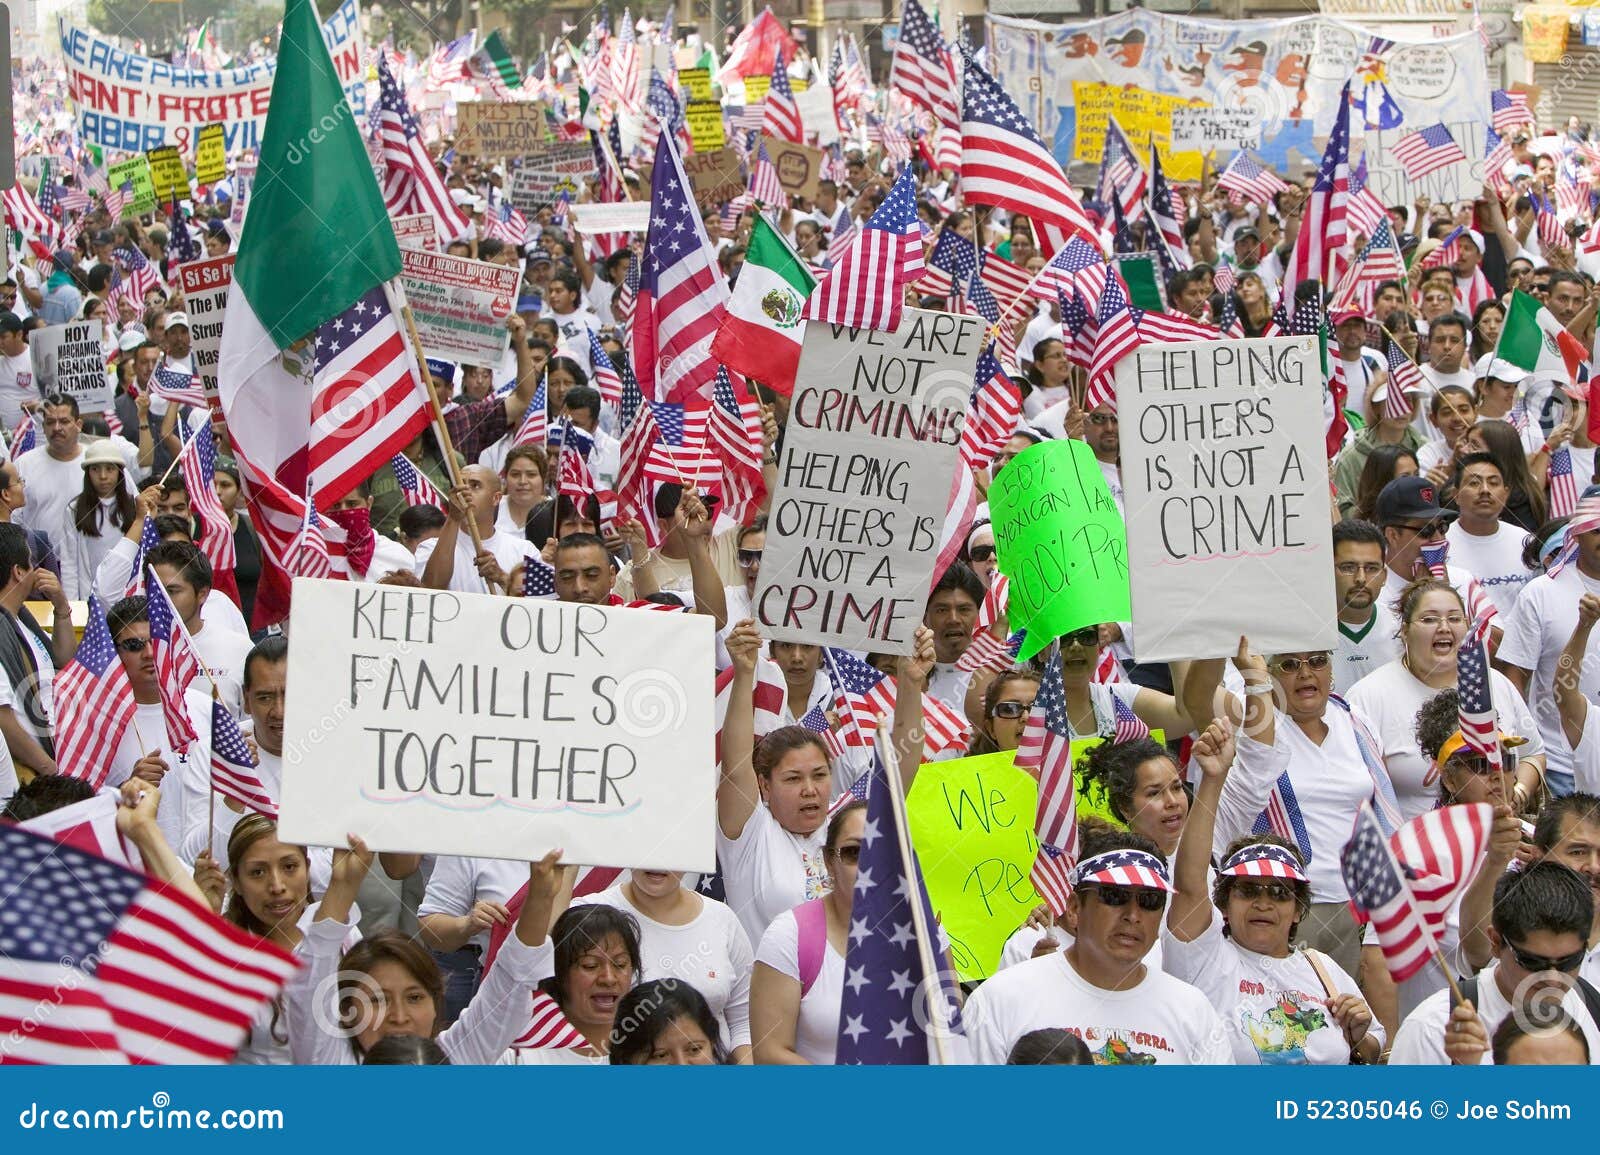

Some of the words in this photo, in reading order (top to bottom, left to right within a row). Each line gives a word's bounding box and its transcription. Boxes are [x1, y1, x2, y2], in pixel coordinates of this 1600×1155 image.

[61, 17, 89, 65] WE
[90, 39, 149, 82] ARE
[150, 62, 222, 88] PART
[158, 88, 271, 122] PROTE
[460, 103, 509, 120] THIS
[516, 103, 539, 120] IS
[82, 110, 165, 152] ABOR
[458, 124, 470, 137] A
[476, 122, 538, 138] NATION
[482, 139, 544, 151] IMMIGRANTS
[1239, 139, 1257, 151] US
[203, 266, 220, 283] Se
[406, 279, 417, 288] To
[419, 281, 446, 295] Action
[409, 252, 431, 268] GREAT
[432, 256, 466, 274] AMERICAN
[466, 263, 498, 280] BOYCOTT
[188, 298, 212, 315] The
[215, 292, 228, 309] W
[58, 341, 101, 360] MARCHAMOS
[65, 325, 90, 342] HOY
[192, 321, 223, 341] Strug
[903, 314, 977, 356] ARE
[196, 351, 219, 367] Has
[852, 354, 936, 396] NOT
[1136, 345, 1304, 393] HELPING
[58, 373, 106, 392] VOTAMOS
[203, 375, 218, 391] Bo
[794, 387, 965, 446] CRIMINALS
[1139, 397, 1275, 444] OTHERS
[783, 447, 911, 504] HELPING
[1003, 455, 1056, 508] 50%
[1145, 454, 1173, 492] IS
[1193, 446, 1265, 489] NOT
[1279, 444, 1305, 485] A
[775, 498, 896, 548] OTHERS
[908, 515, 935, 552] IS
[1160, 493, 1305, 559] CRIME
[797, 546, 866, 584] NOT
[866, 555, 897, 588] A
[1072, 523, 1129, 580] PR
[352, 588, 461, 643] KEEP
[500, 603, 609, 657] OUR
[758, 584, 915, 643] CRIME
[350, 653, 619, 726] FAMILIES
[363, 727, 637, 807] TOGETHER
[942, 772, 1017, 834] We
